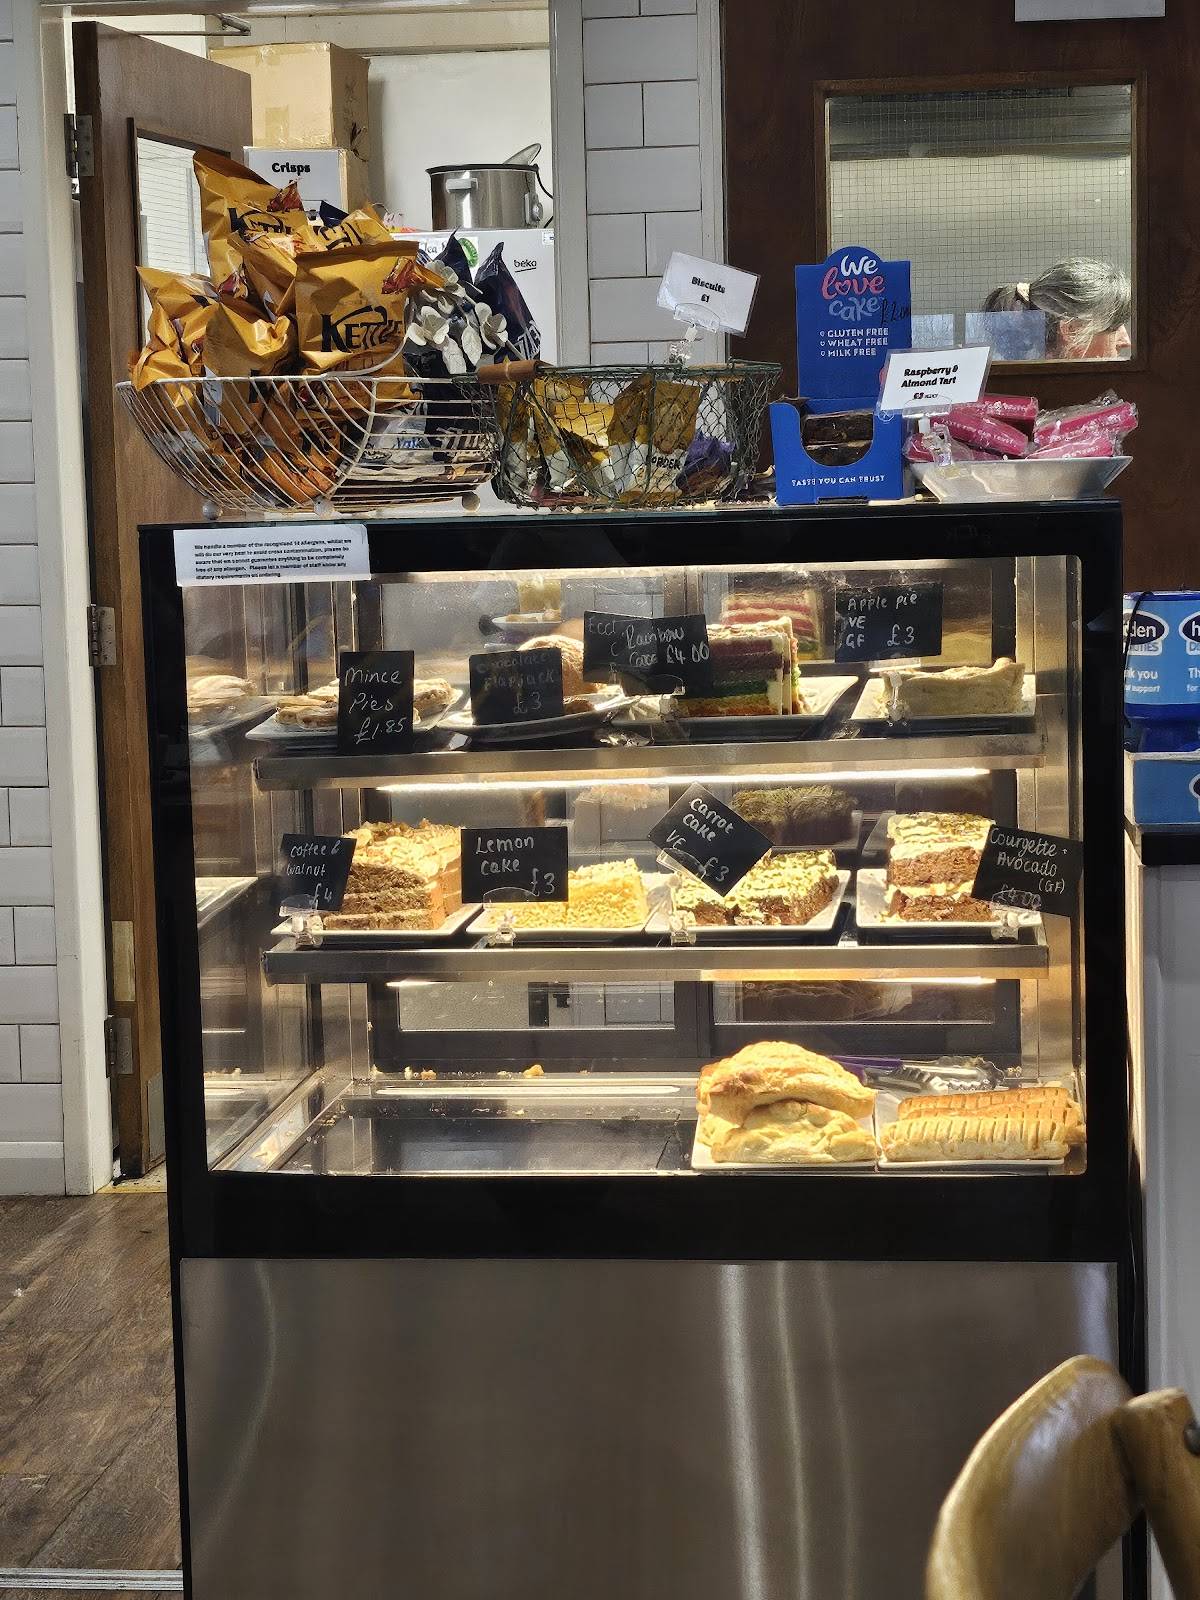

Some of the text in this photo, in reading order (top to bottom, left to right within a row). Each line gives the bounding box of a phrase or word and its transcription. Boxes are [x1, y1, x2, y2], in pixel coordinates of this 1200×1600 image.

[272, 162, 311, 176] Crisps
[841, 254, 878, 276] We
[692, 277, 726, 294] Biscuits
[822, 267, 885, 299] love
[829, 297, 881, 321] cake
[828, 328, 889, 338] GLUTEN FREE
[828, 339, 862, 347] WHEAT
[828, 348, 877, 357] MILK FREE
[901, 376, 957, 388] Almond Tart
[904, 367, 951, 378] Raspberry
[792, 479, 816, 487] TASTE
[859, 475, 885, 483] TRUST
[848, 593, 918, 612] Apple pie
[849, 615, 866, 629] VE
[626, 624, 685, 649] Rainbow
[846, 624, 915, 649] GF £3
[345, 667, 402, 687] Mince
[1138, 670, 1158, 681] you
[354, 717, 407, 745] £1.85
[476, 837, 534, 855] Lemon
[990, 828, 1058, 858] Courgette
[700, 857, 730, 882] £3
[997, 851, 1058, 877] Avocado
[530, 868, 555, 897] £3
[1039, 878, 1065, 895] (GF)
[310, 883, 333, 904] £4
